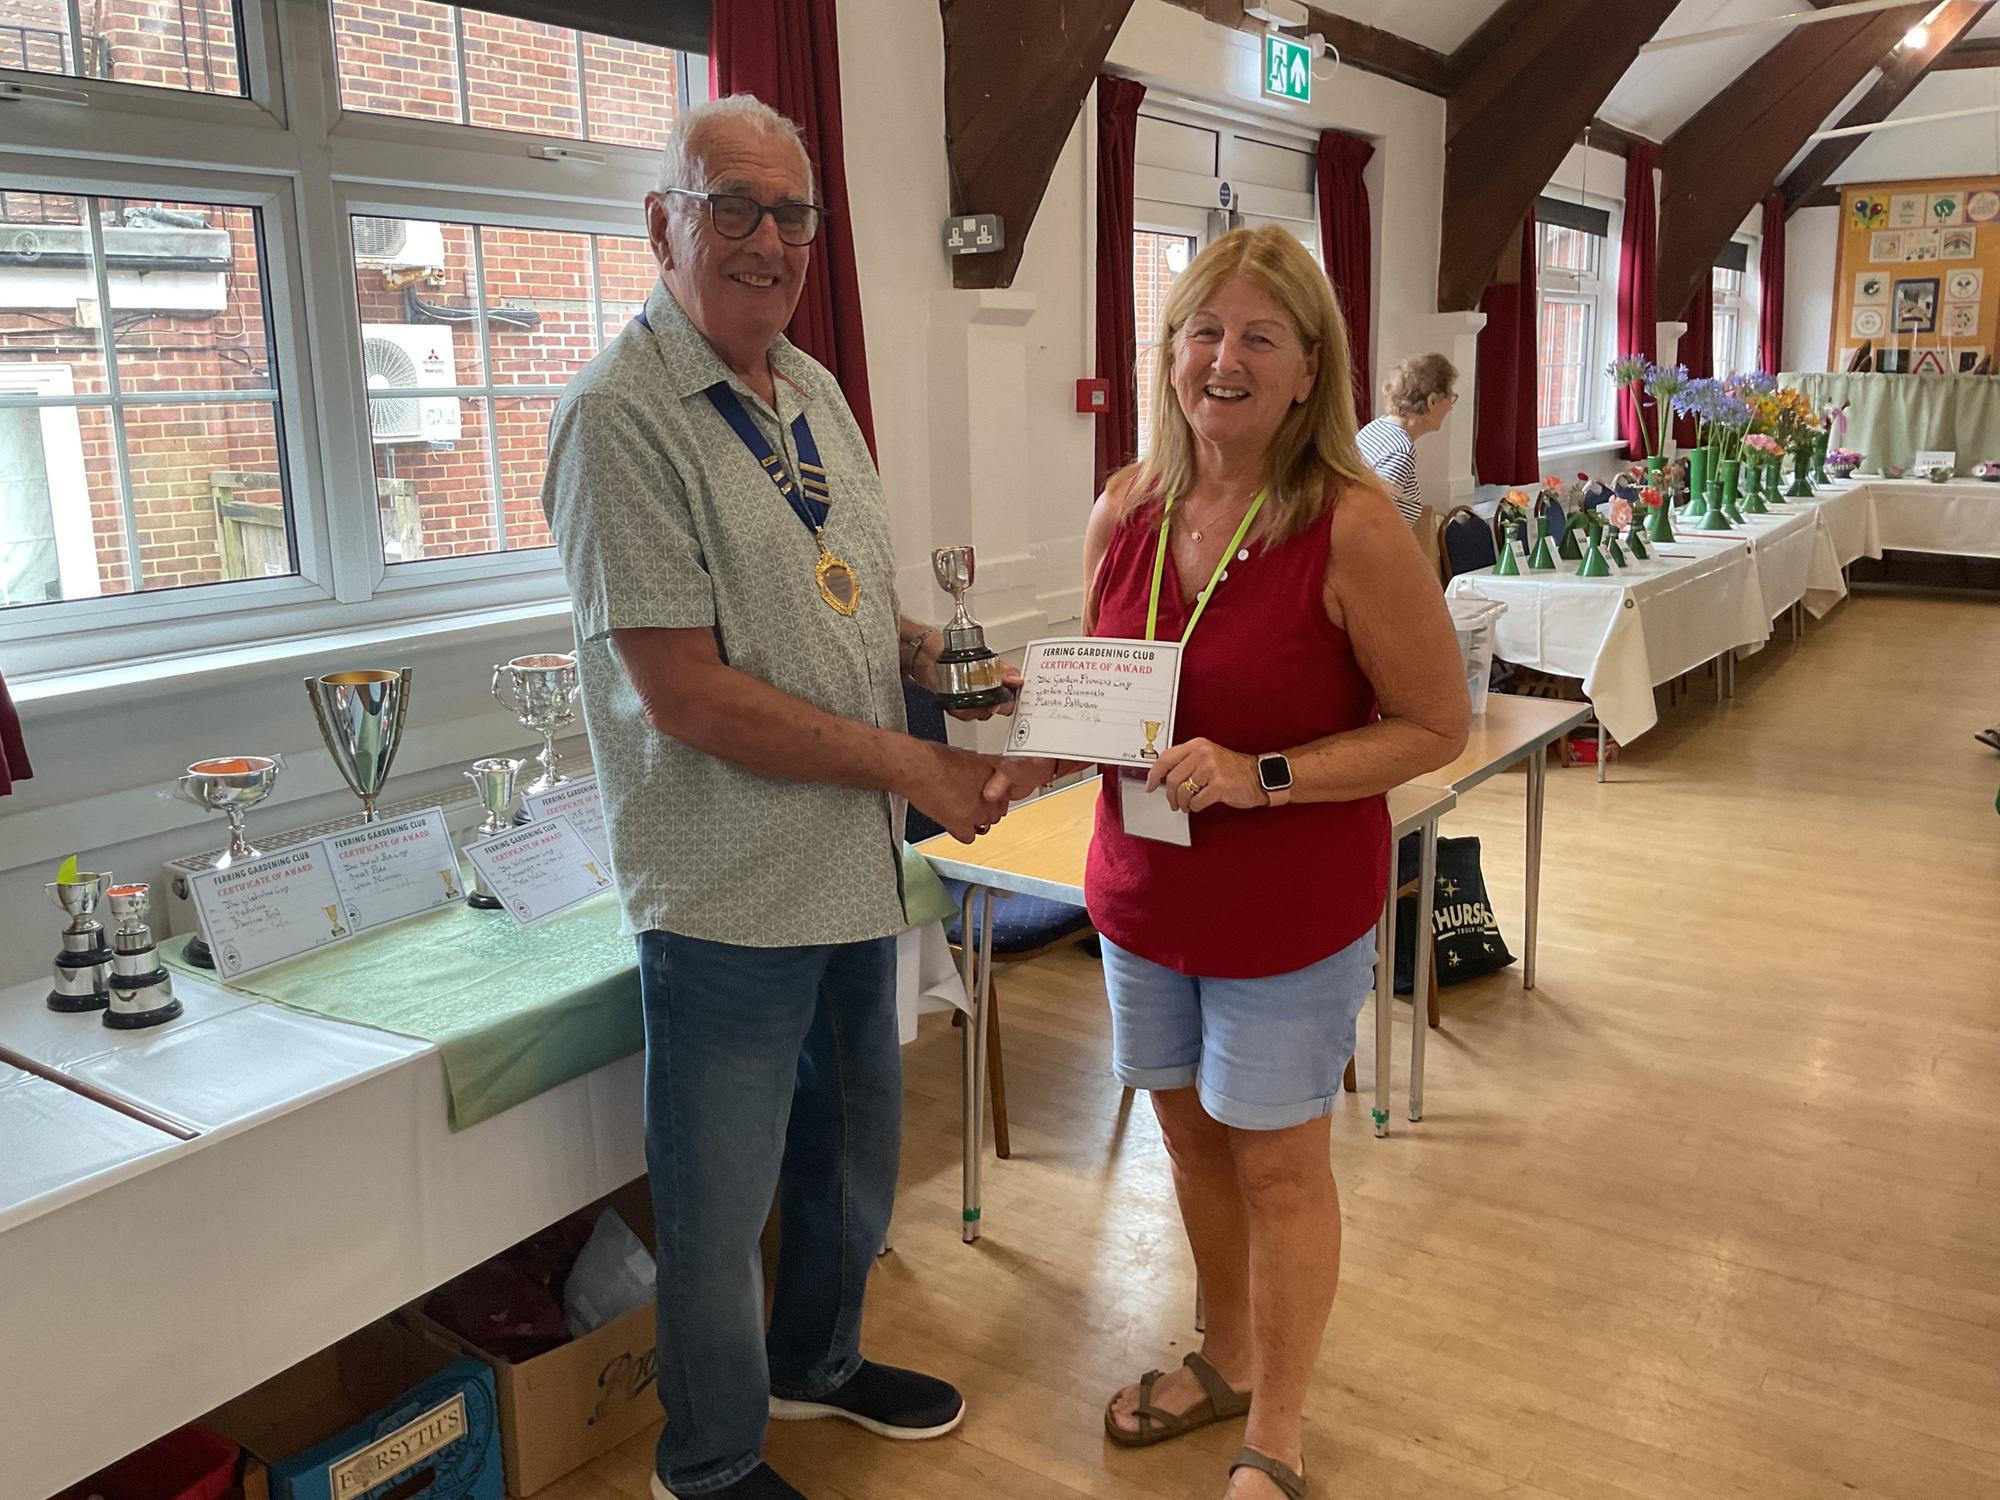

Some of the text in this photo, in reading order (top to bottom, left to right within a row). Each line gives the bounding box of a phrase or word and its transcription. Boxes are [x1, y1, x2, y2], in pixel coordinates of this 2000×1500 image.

[1040, 661, 1153, 675] CERTIFICATE OF AWARD
[1043, 647, 1155, 661] FERRING GARDENING CLUB
[1053, 674, 1079, 687] Garden
[542, 793, 566, 806] FERRING
[334, 818, 427, 848] FERRING GARDENING CLUB
[339, 830, 430, 860] CERTIFICATE OF AWARD
[484, 822, 558, 855] FERRING GARDENING CLUB
[491, 843, 531, 863] CERTIFICATE
[540, 831, 563, 845] AWARD
[213, 851, 310, 885] FERRING GARDENING CLUB
[217, 863, 313, 897] CERTIFICATE OF AWARD
[340, 1409, 459, 1490] FRSYTH'S
